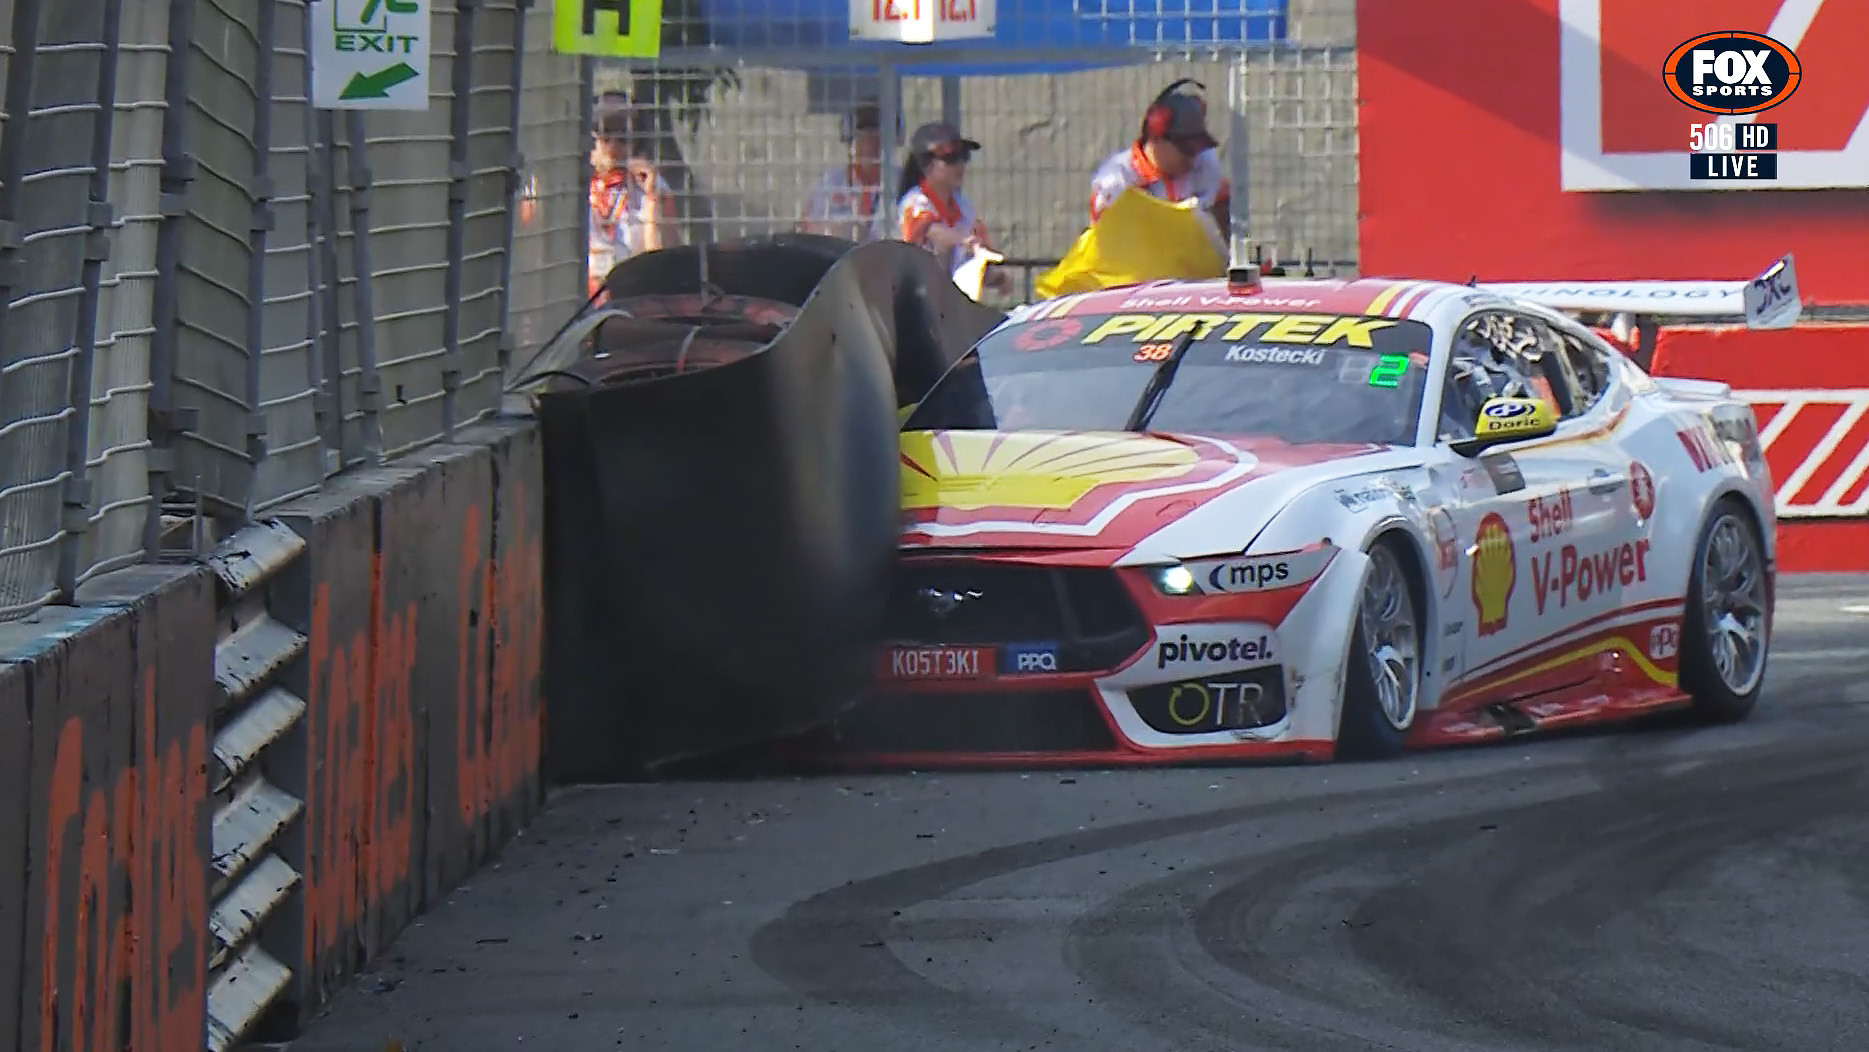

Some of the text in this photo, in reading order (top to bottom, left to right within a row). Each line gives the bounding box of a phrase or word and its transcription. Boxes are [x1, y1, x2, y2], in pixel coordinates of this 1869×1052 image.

[335, 34, 419, 53] EXIT
[1120, 295, 1321, 309] Shell V-Power
[1081, 312, 1399, 349] PIRTEK
[1133, 343, 1174, 363] 38
[1224, 345, 1325, 366] Kostecki
[1489, 418, 1541, 431] Doric
[1527, 488, 1574, 543] Shell
[1229, 561, 1290, 588] mps
[1531, 538, 1651, 616] V-Power
[1017, 652, 1058, 671] PPQ
[1157, 633, 1273, 670] pivotel.
[1168, 682, 1265, 727] OTR
